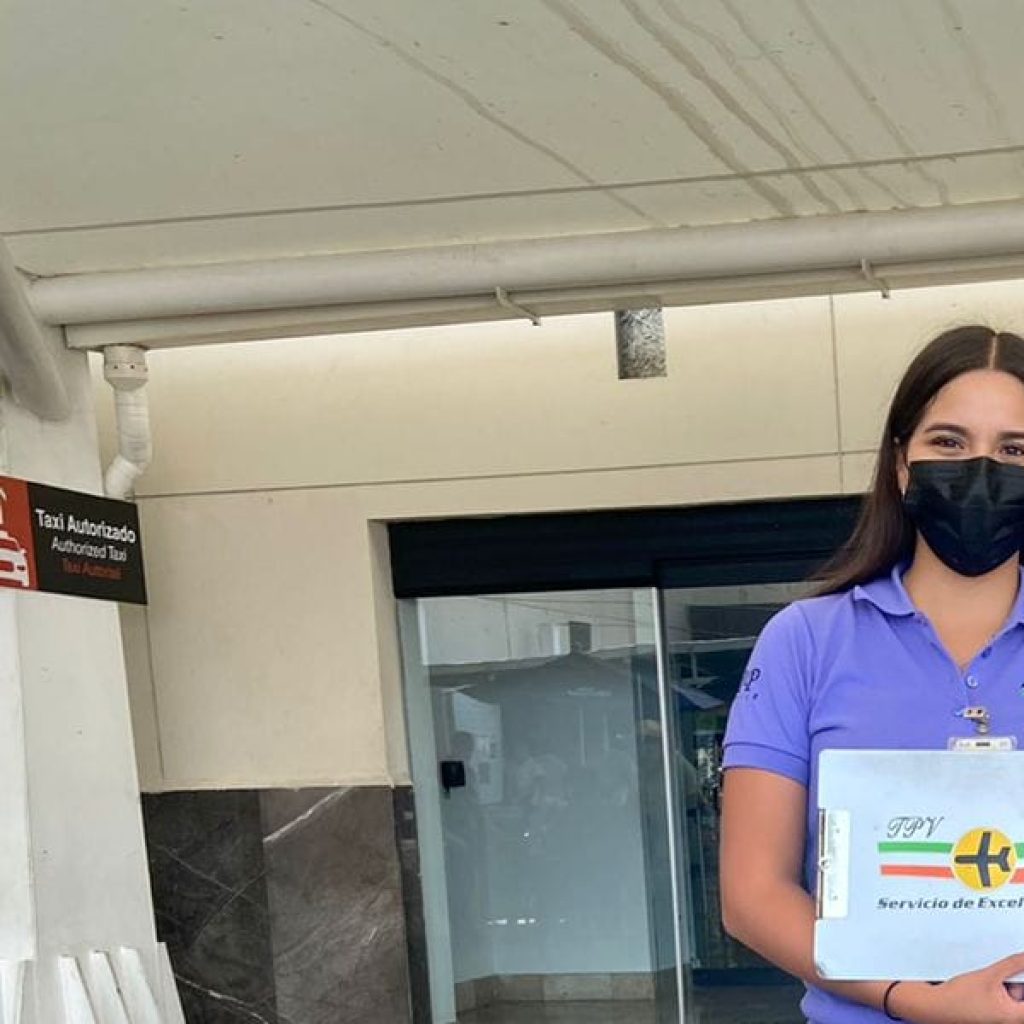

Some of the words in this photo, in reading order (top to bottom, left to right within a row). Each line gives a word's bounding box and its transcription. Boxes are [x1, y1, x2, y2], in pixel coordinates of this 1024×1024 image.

[35, 508, 64, 531] Taxi
[67, 515, 136, 543] Autorizado
[51, 536, 107, 559] Authorized
[108, 545, 127, 562] Taxi
[886, 815, 945, 839] TPV
[876, 897, 948, 909] Servicio
[948, 897, 975, 909] de
